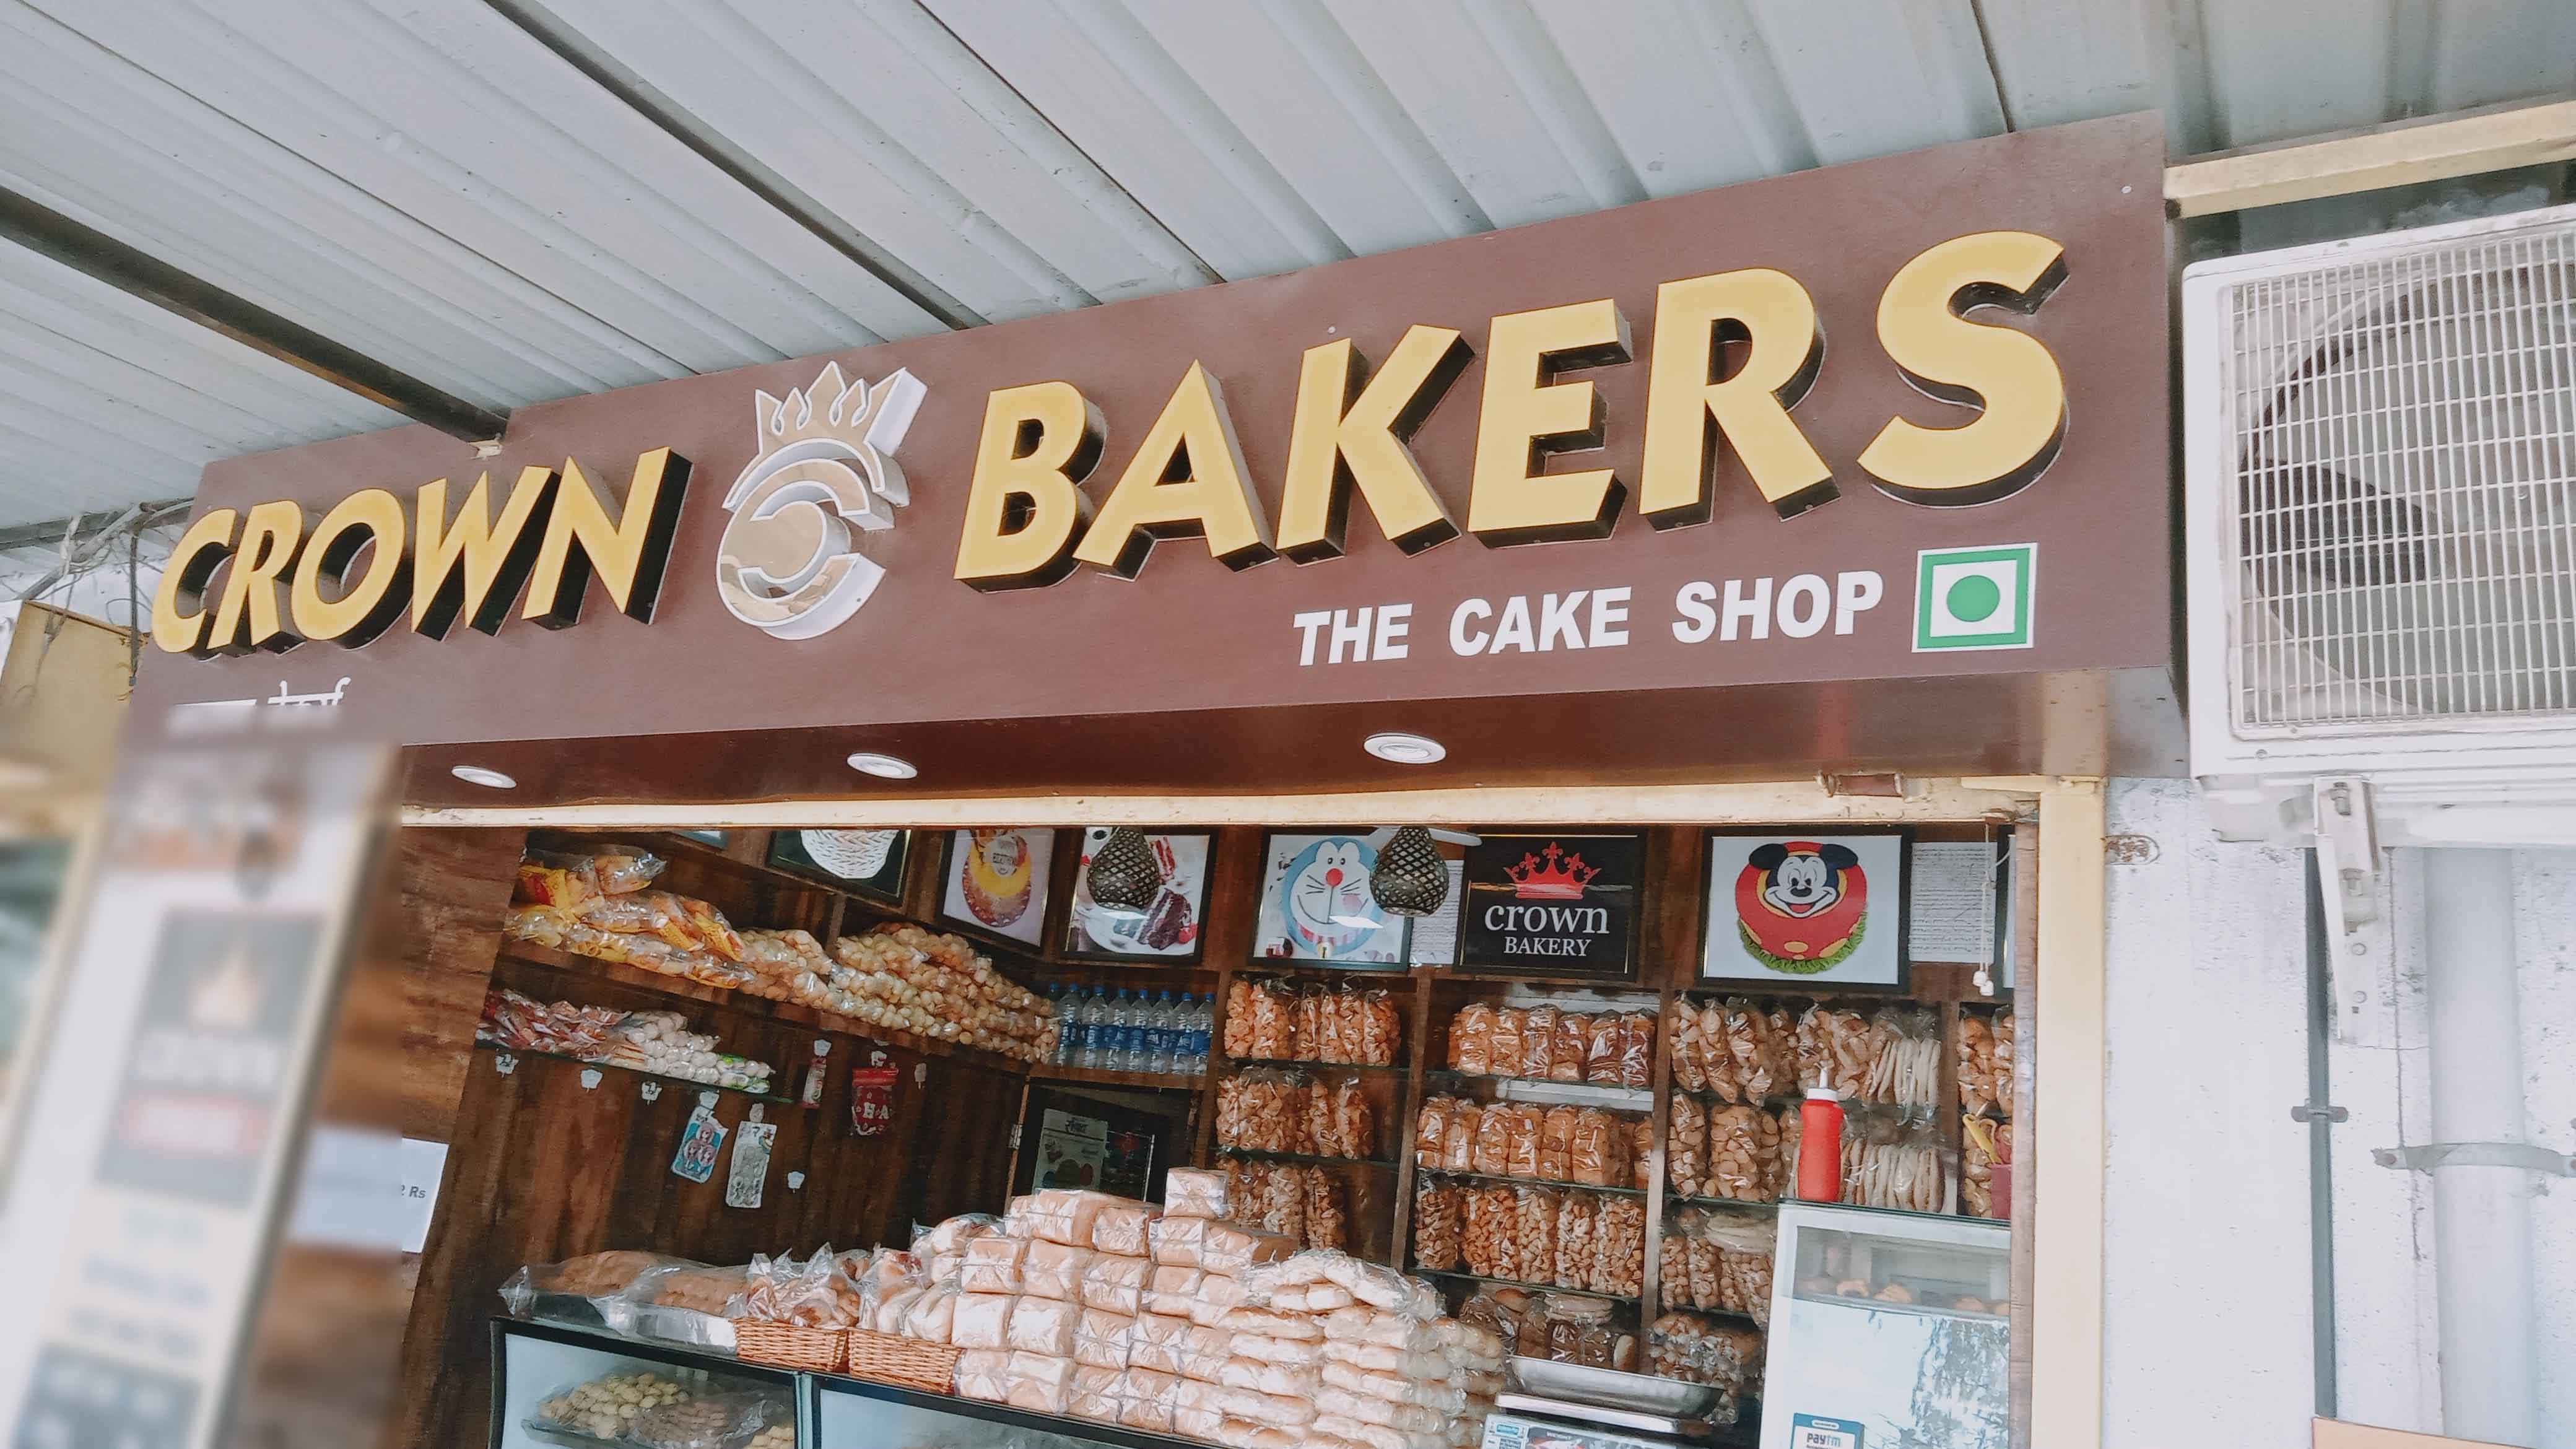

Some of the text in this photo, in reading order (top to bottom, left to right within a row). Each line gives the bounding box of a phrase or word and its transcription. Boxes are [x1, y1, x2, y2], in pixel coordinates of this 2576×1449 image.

[151, 230, 2069, 660] CROWN BAKERS
[1292, 570, 1884, 666] THE CAKE SHOP
[1484, 905, 1610, 934] crown
[1503, 936, 1592, 957] BAKERY
[409, 1185, 427, 1199] Rs
